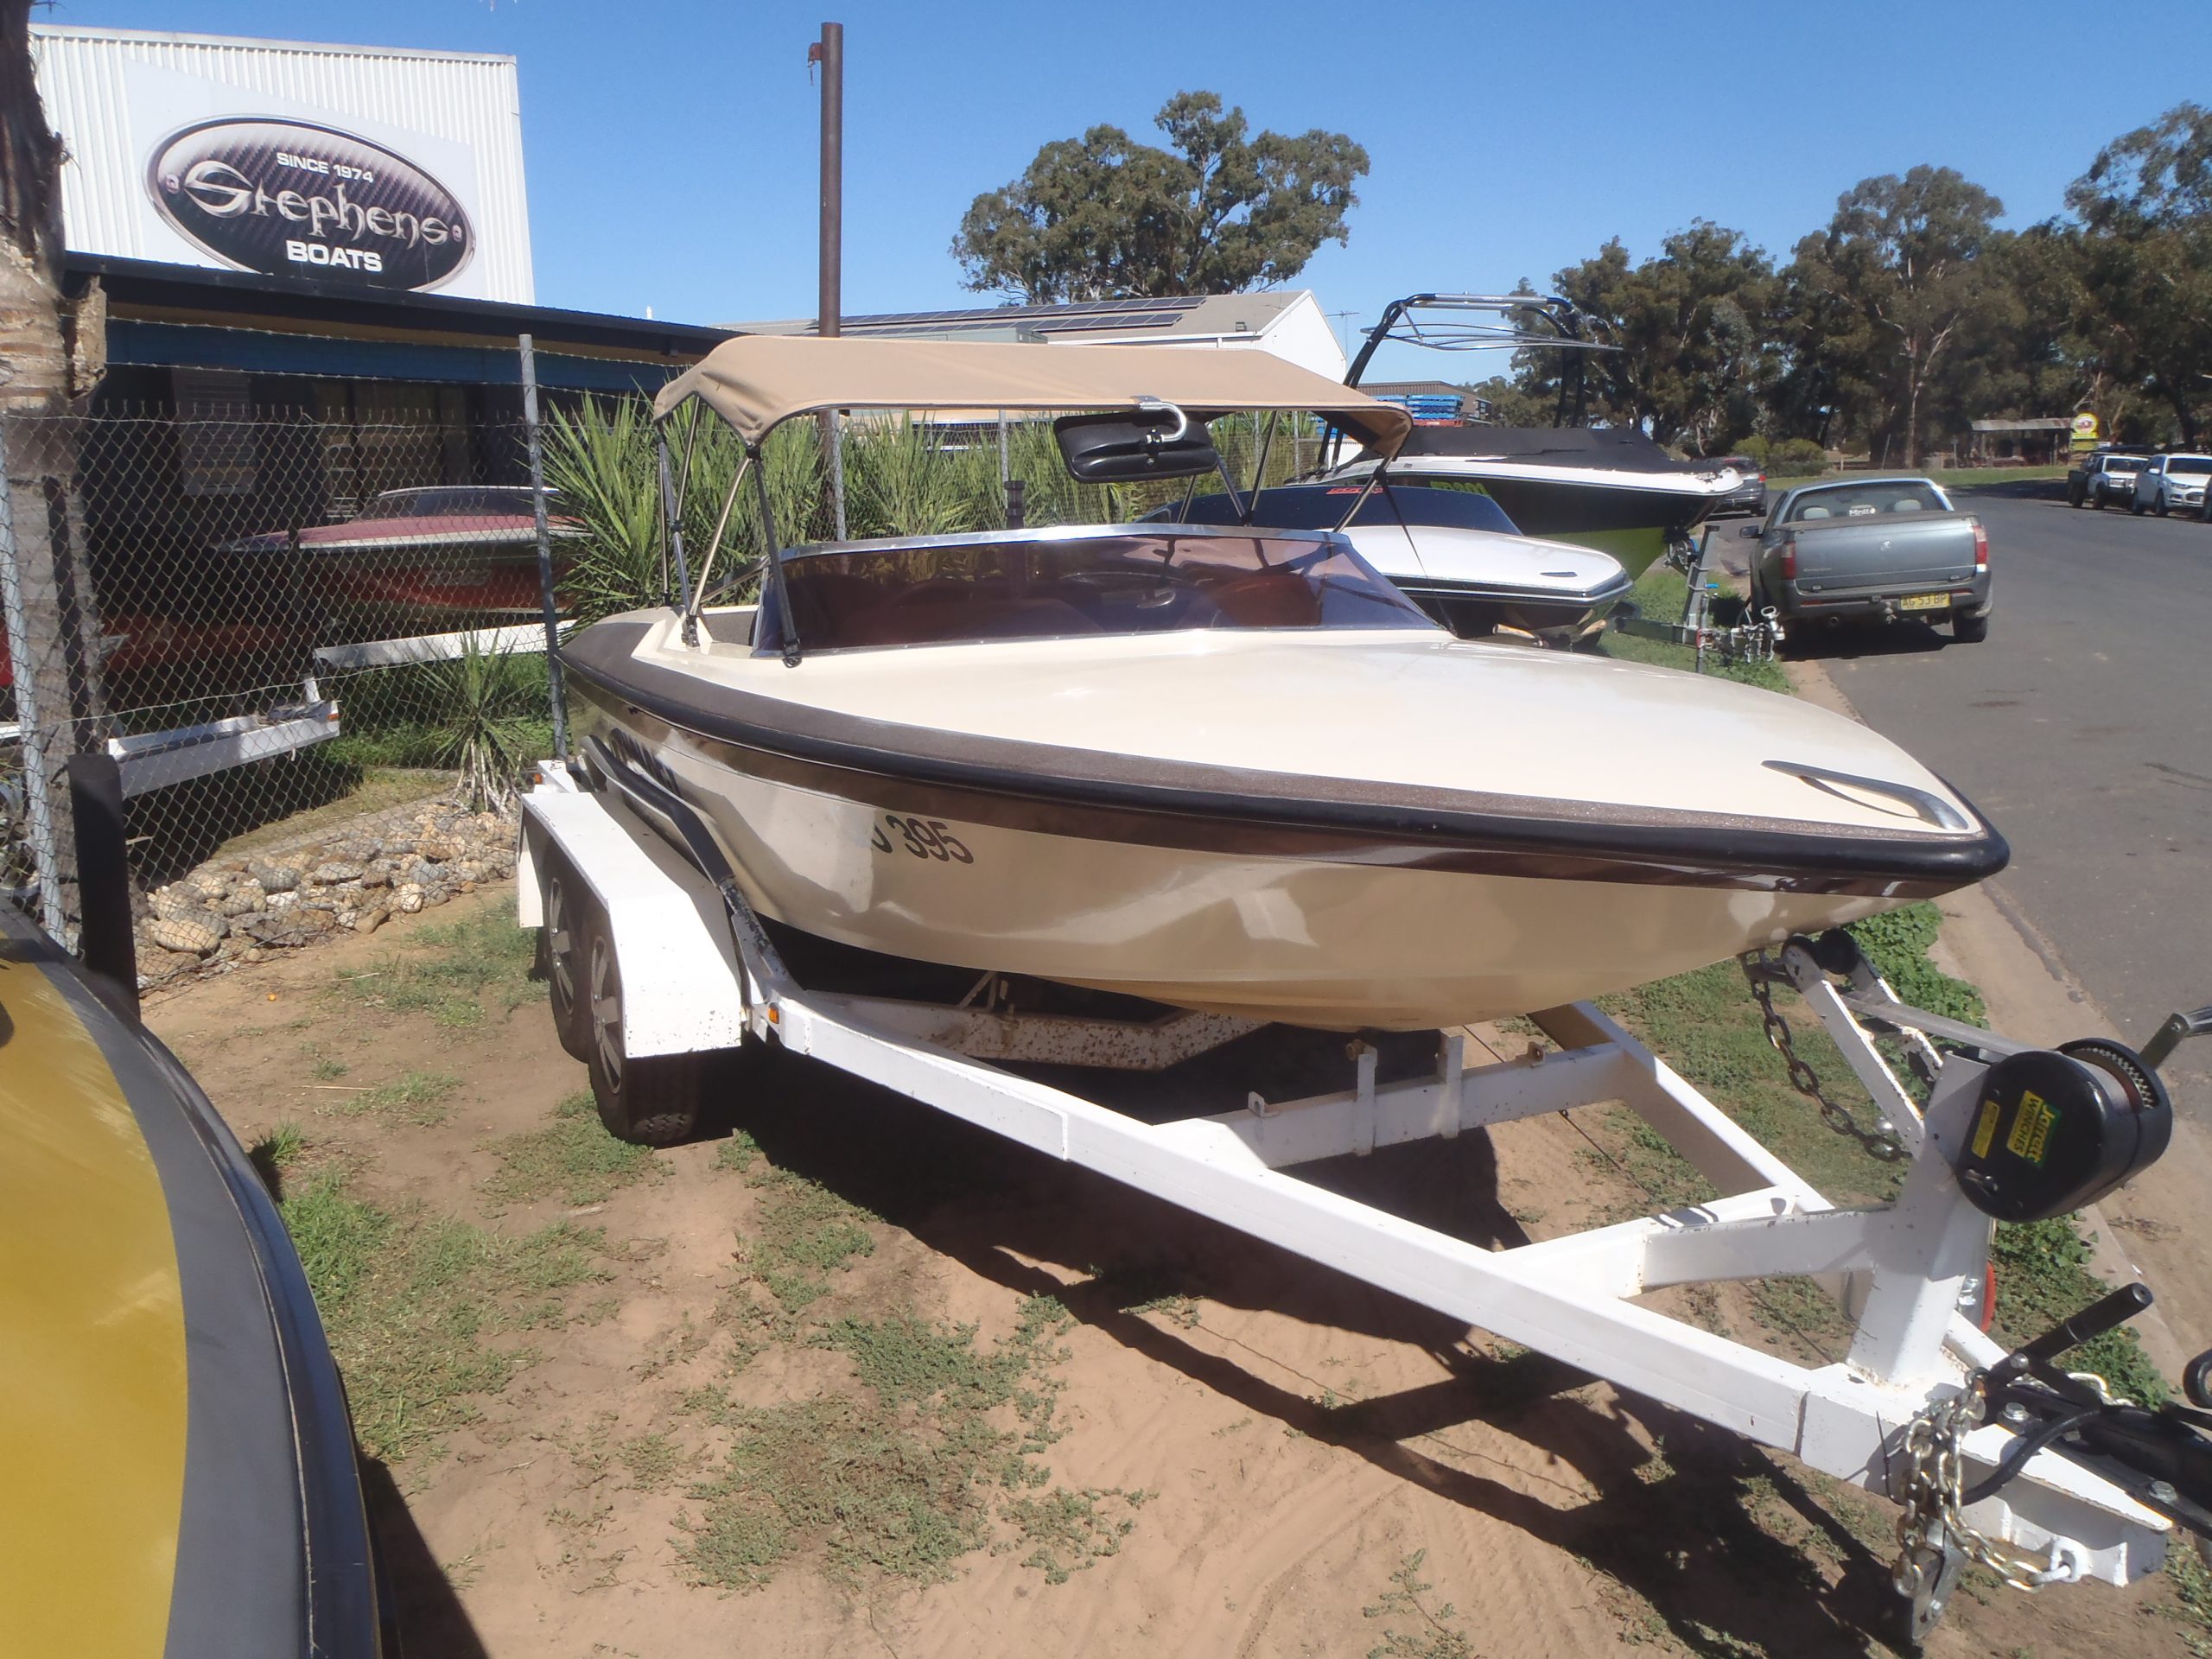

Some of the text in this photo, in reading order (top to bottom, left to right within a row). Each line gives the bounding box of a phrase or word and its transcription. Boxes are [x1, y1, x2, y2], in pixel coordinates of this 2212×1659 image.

[276, 151, 374, 184] SINCE 1974
[183, 160, 449, 249] Stephens
[285, 239, 383, 272] BOATS
[885, 815, 975, 864] 395
[2014, 1097, 2040, 1152] WINCHES
[2029, 1104, 2056, 1163] Jarrett
